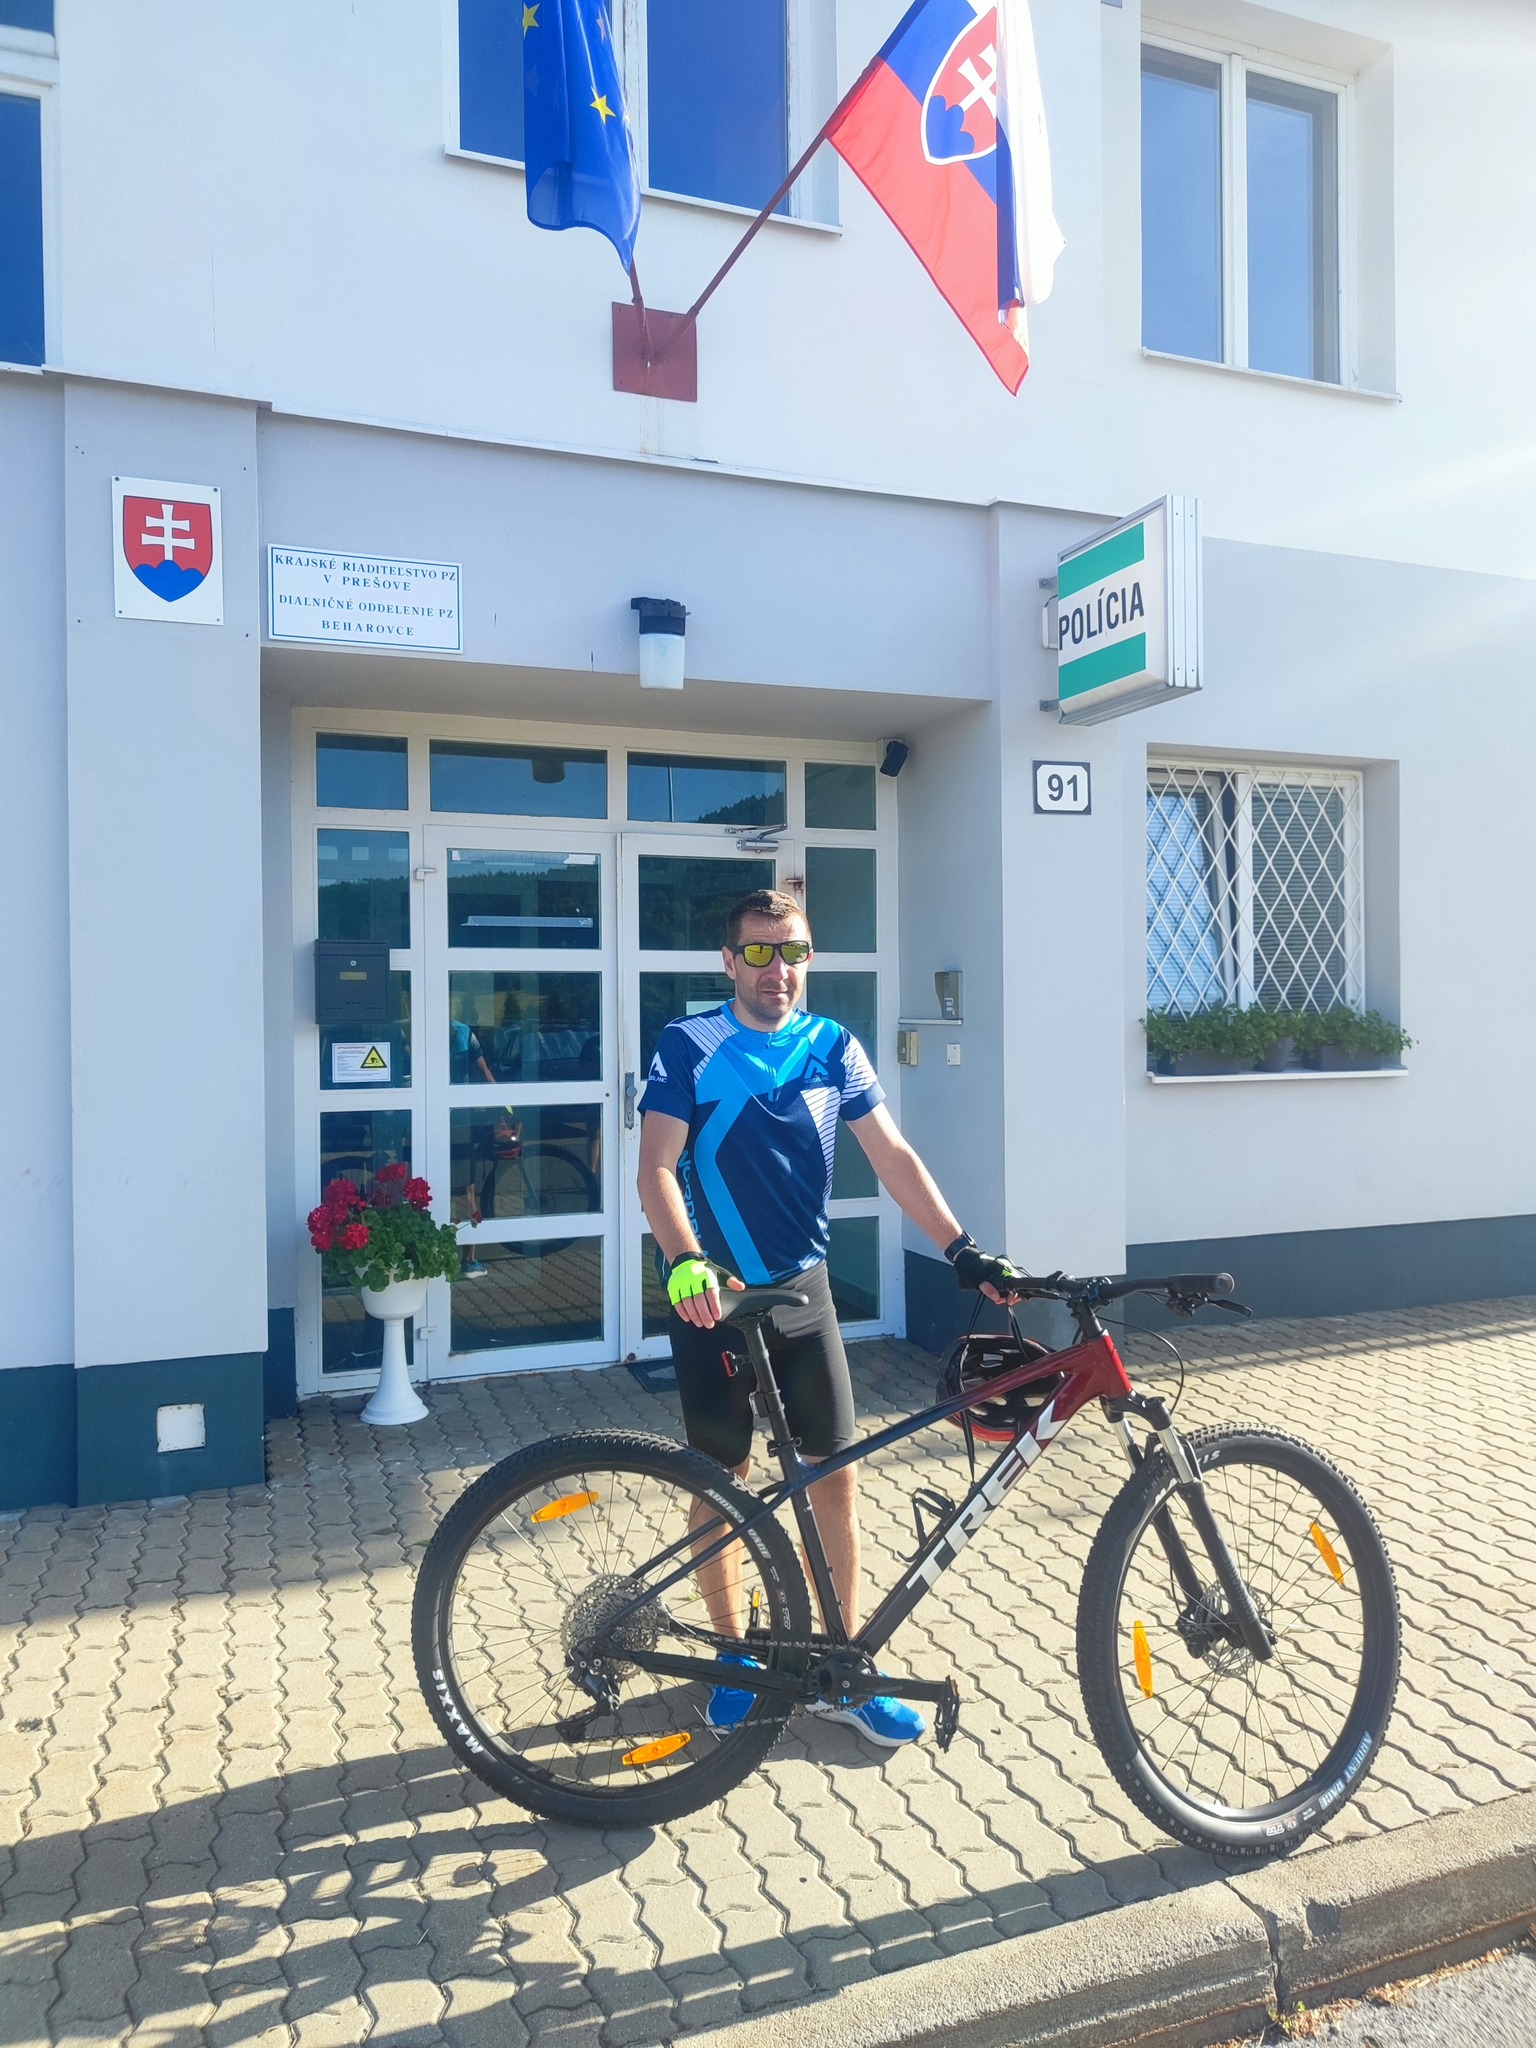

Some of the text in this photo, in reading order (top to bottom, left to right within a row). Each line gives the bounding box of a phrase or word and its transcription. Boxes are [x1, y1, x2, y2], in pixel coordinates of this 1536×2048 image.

[275, 554, 337, 569] KRAJSKÉ
[441, 571, 456, 581] PZ
[324, 574, 411, 591] V PREŠOVE
[358, 602, 434, 617] ODDELENIE
[439, 608, 454, 619] PZ
[1058, 581, 1145, 651] POLÍCIA
[321, 619, 414, 636] BEHAROVCE
[1047, 773, 1079, 802] 91
[905, 1399, 1068, 1588] TREK
[432, 1668, 484, 1754] MAXXIS
[1318, 1778, 1346, 1811] RACE
